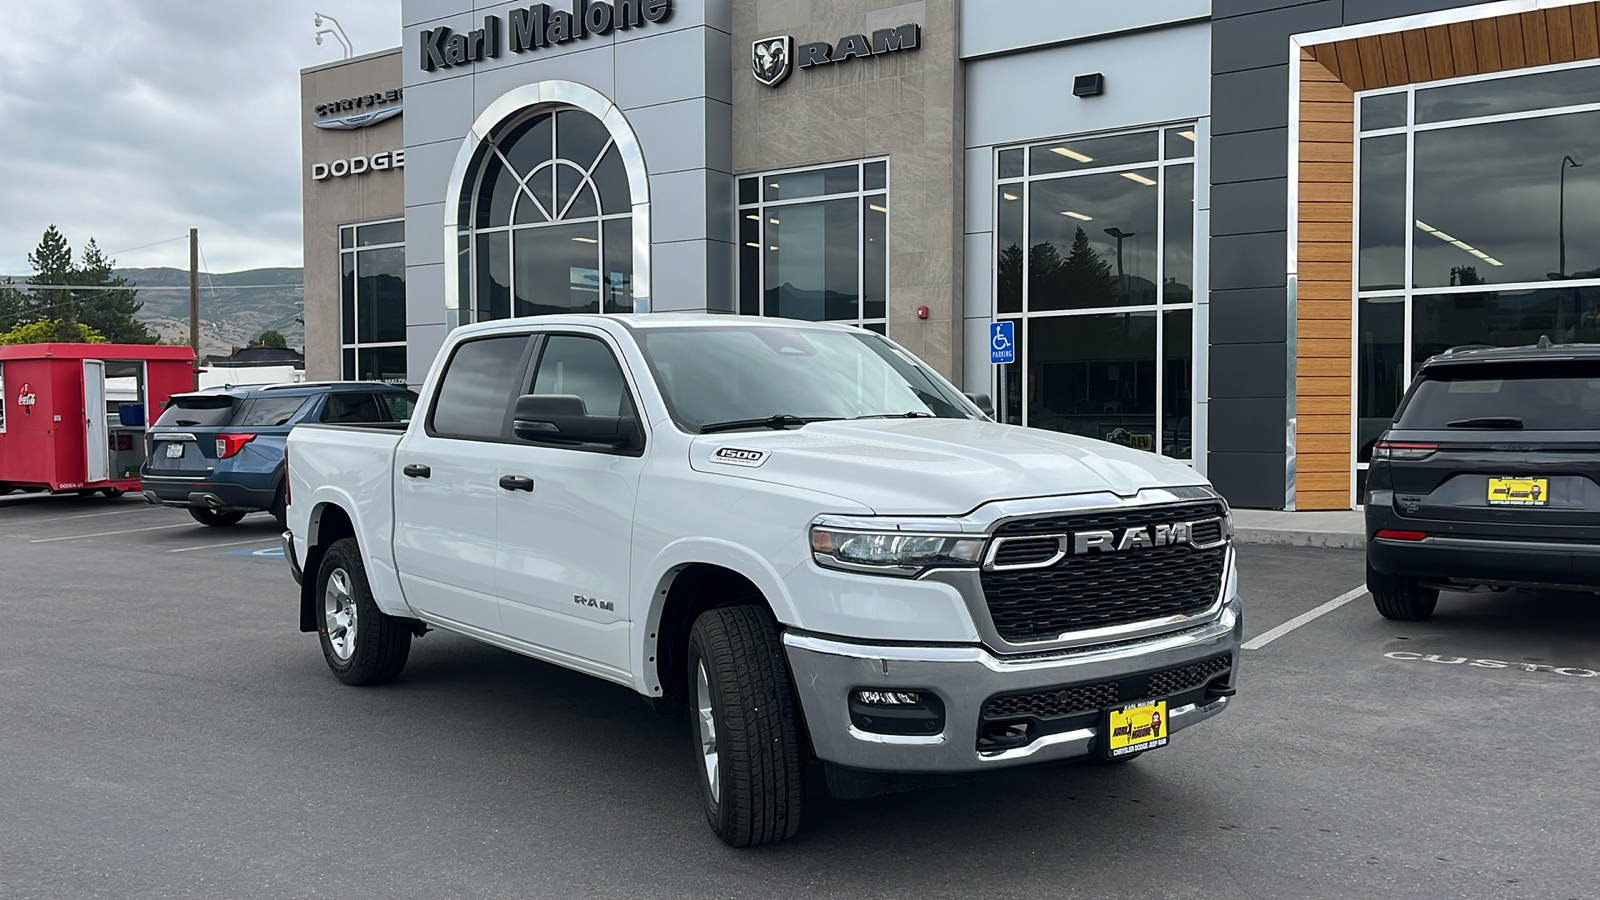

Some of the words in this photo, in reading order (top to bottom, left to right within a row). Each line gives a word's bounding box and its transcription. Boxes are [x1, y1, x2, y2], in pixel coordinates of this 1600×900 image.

[420, 15, 499, 71] Karl
[508, 0, 672, 52] Malone
[798, 22, 921, 68] RAM
[312, 149, 404, 180] DODGE
[720, 449, 761, 460] 1500
[1074, 522, 1187, 554] RAM
[574, 594, 614, 611] RAM
[1384, 652, 1600, 677] CUSTO
[1113, 745, 1135, 756] CHRYSLER
[1135, 742, 1148, 751] DODGE
[1148, 740, 1157, 748] JEEP
[1158, 738, 1166, 746] RAM
